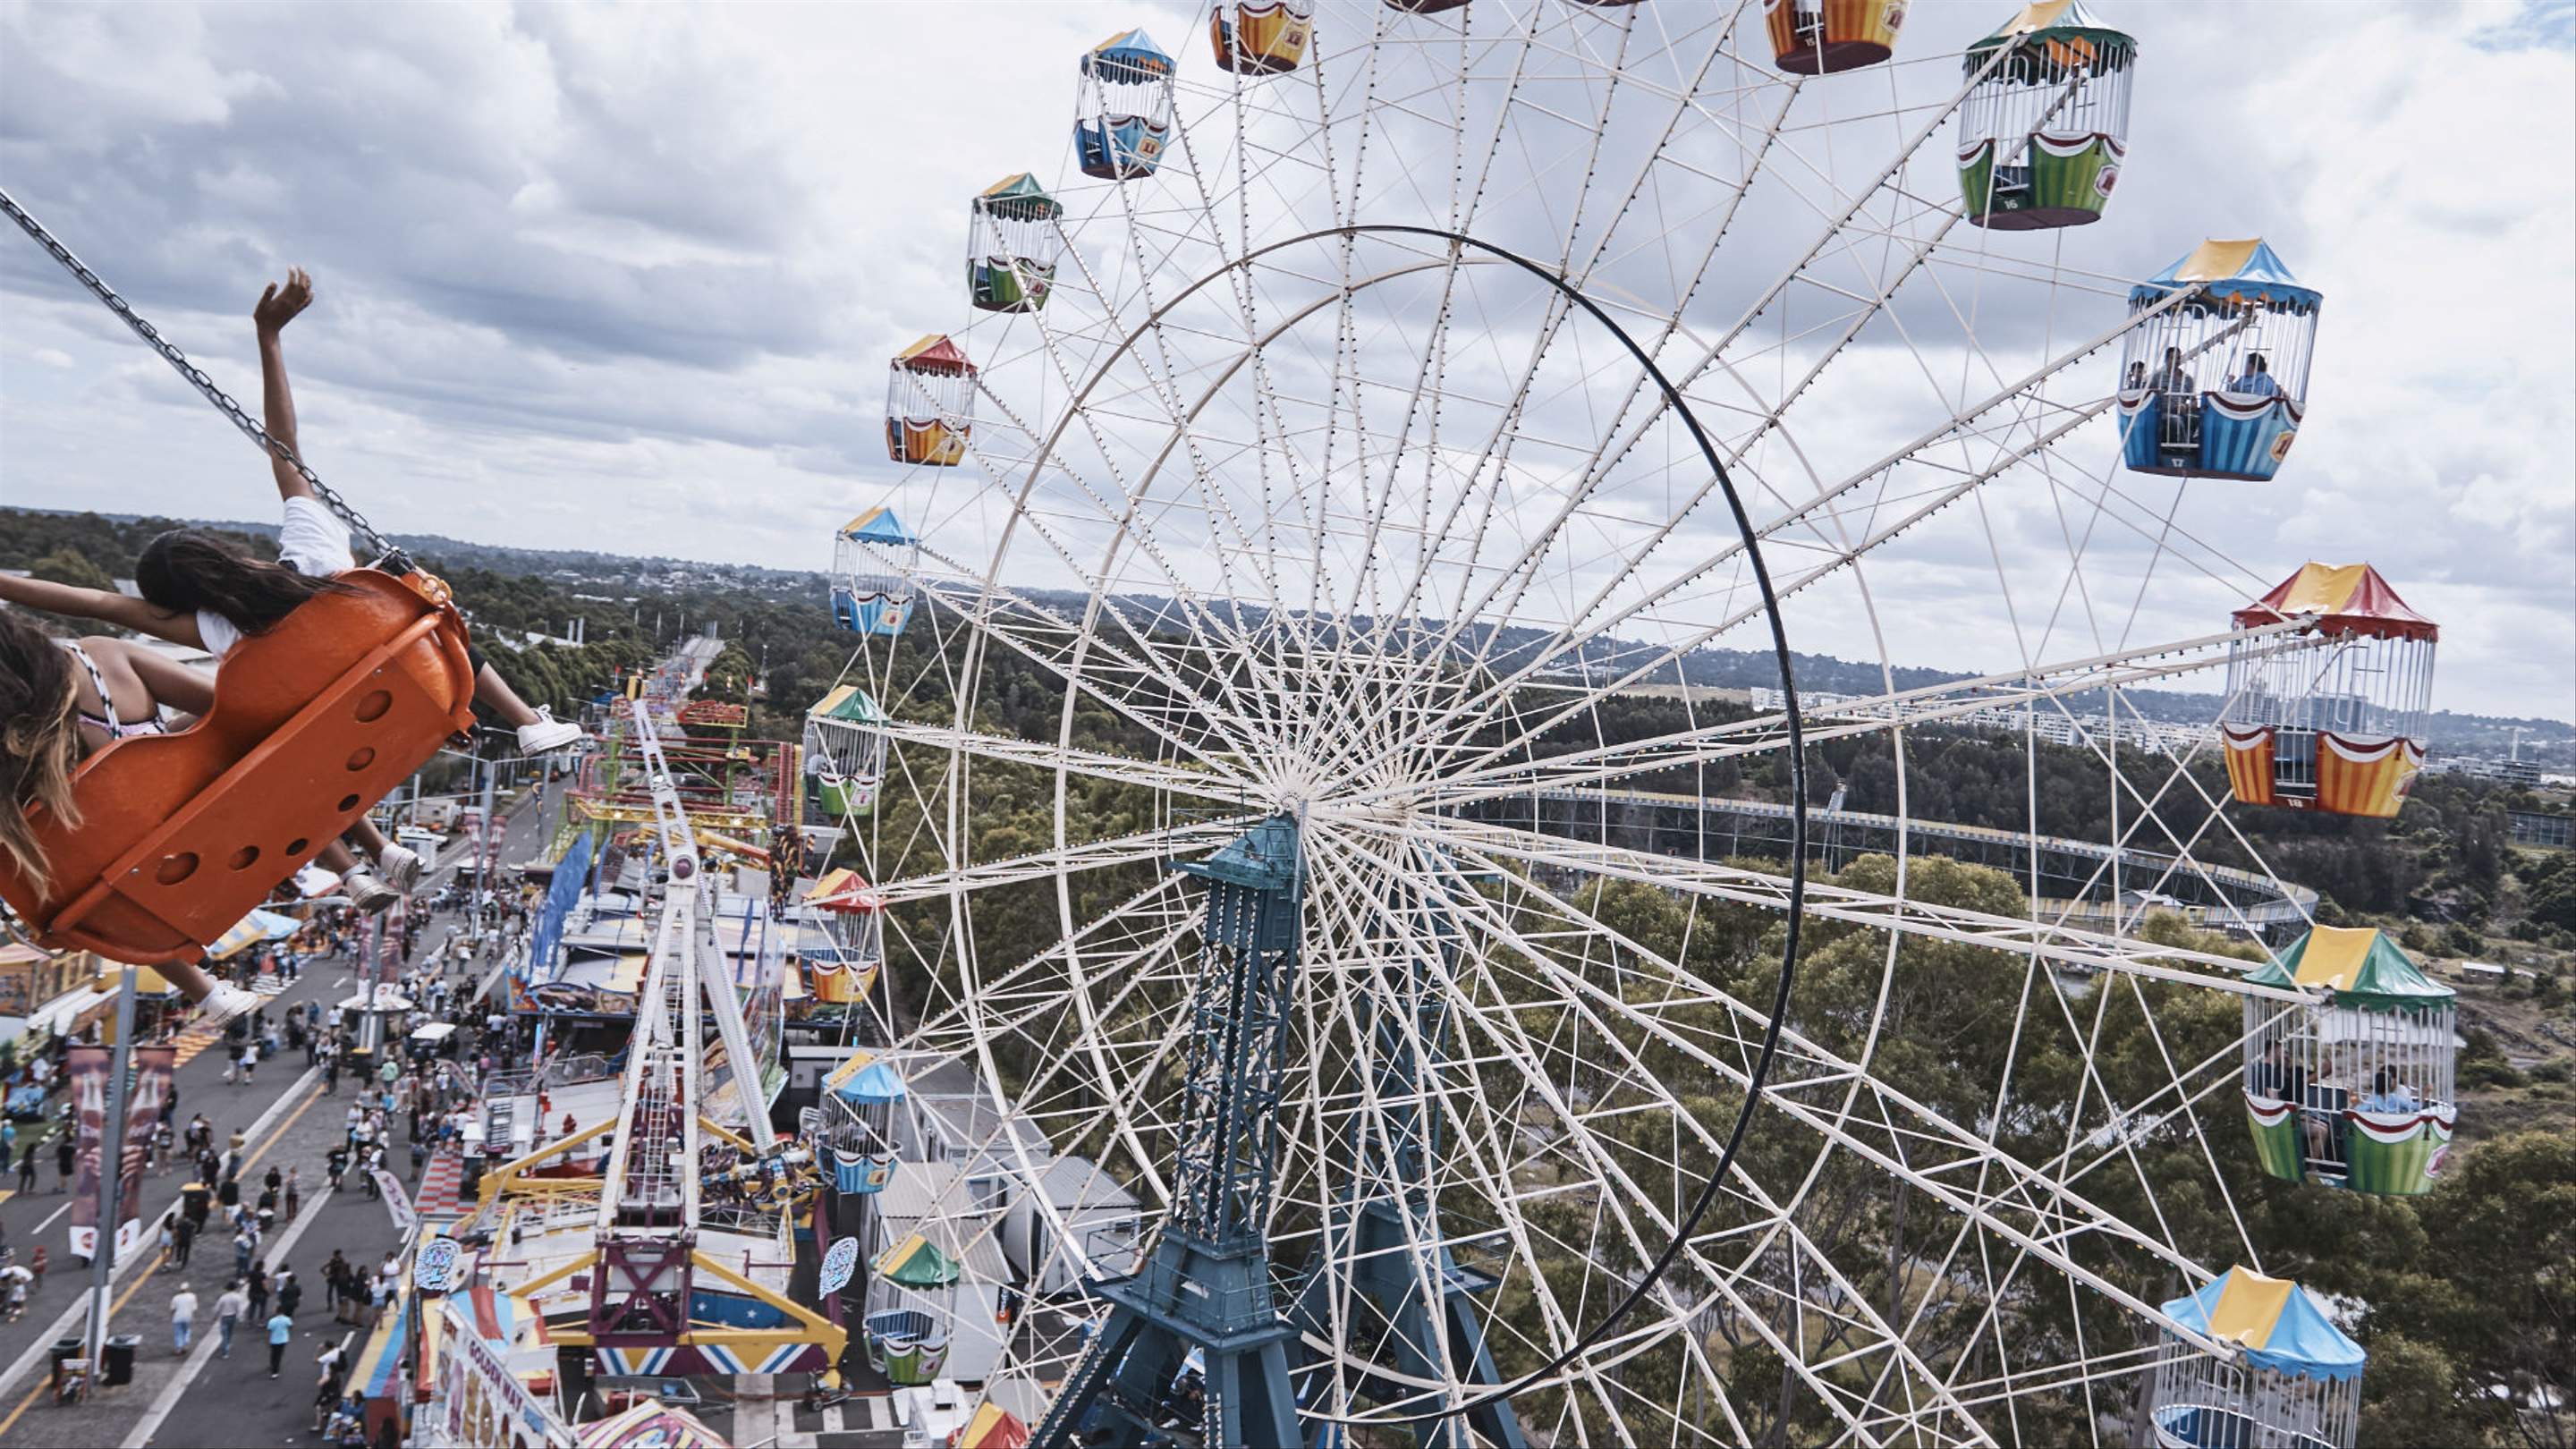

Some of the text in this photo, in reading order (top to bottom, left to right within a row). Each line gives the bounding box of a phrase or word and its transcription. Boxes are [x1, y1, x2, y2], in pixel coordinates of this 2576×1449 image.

[2004, 199, 2018, 209] 16
[2287, 799, 2303, 808] 18
[470, 1340, 523, 1412] GOLDEN WAY
